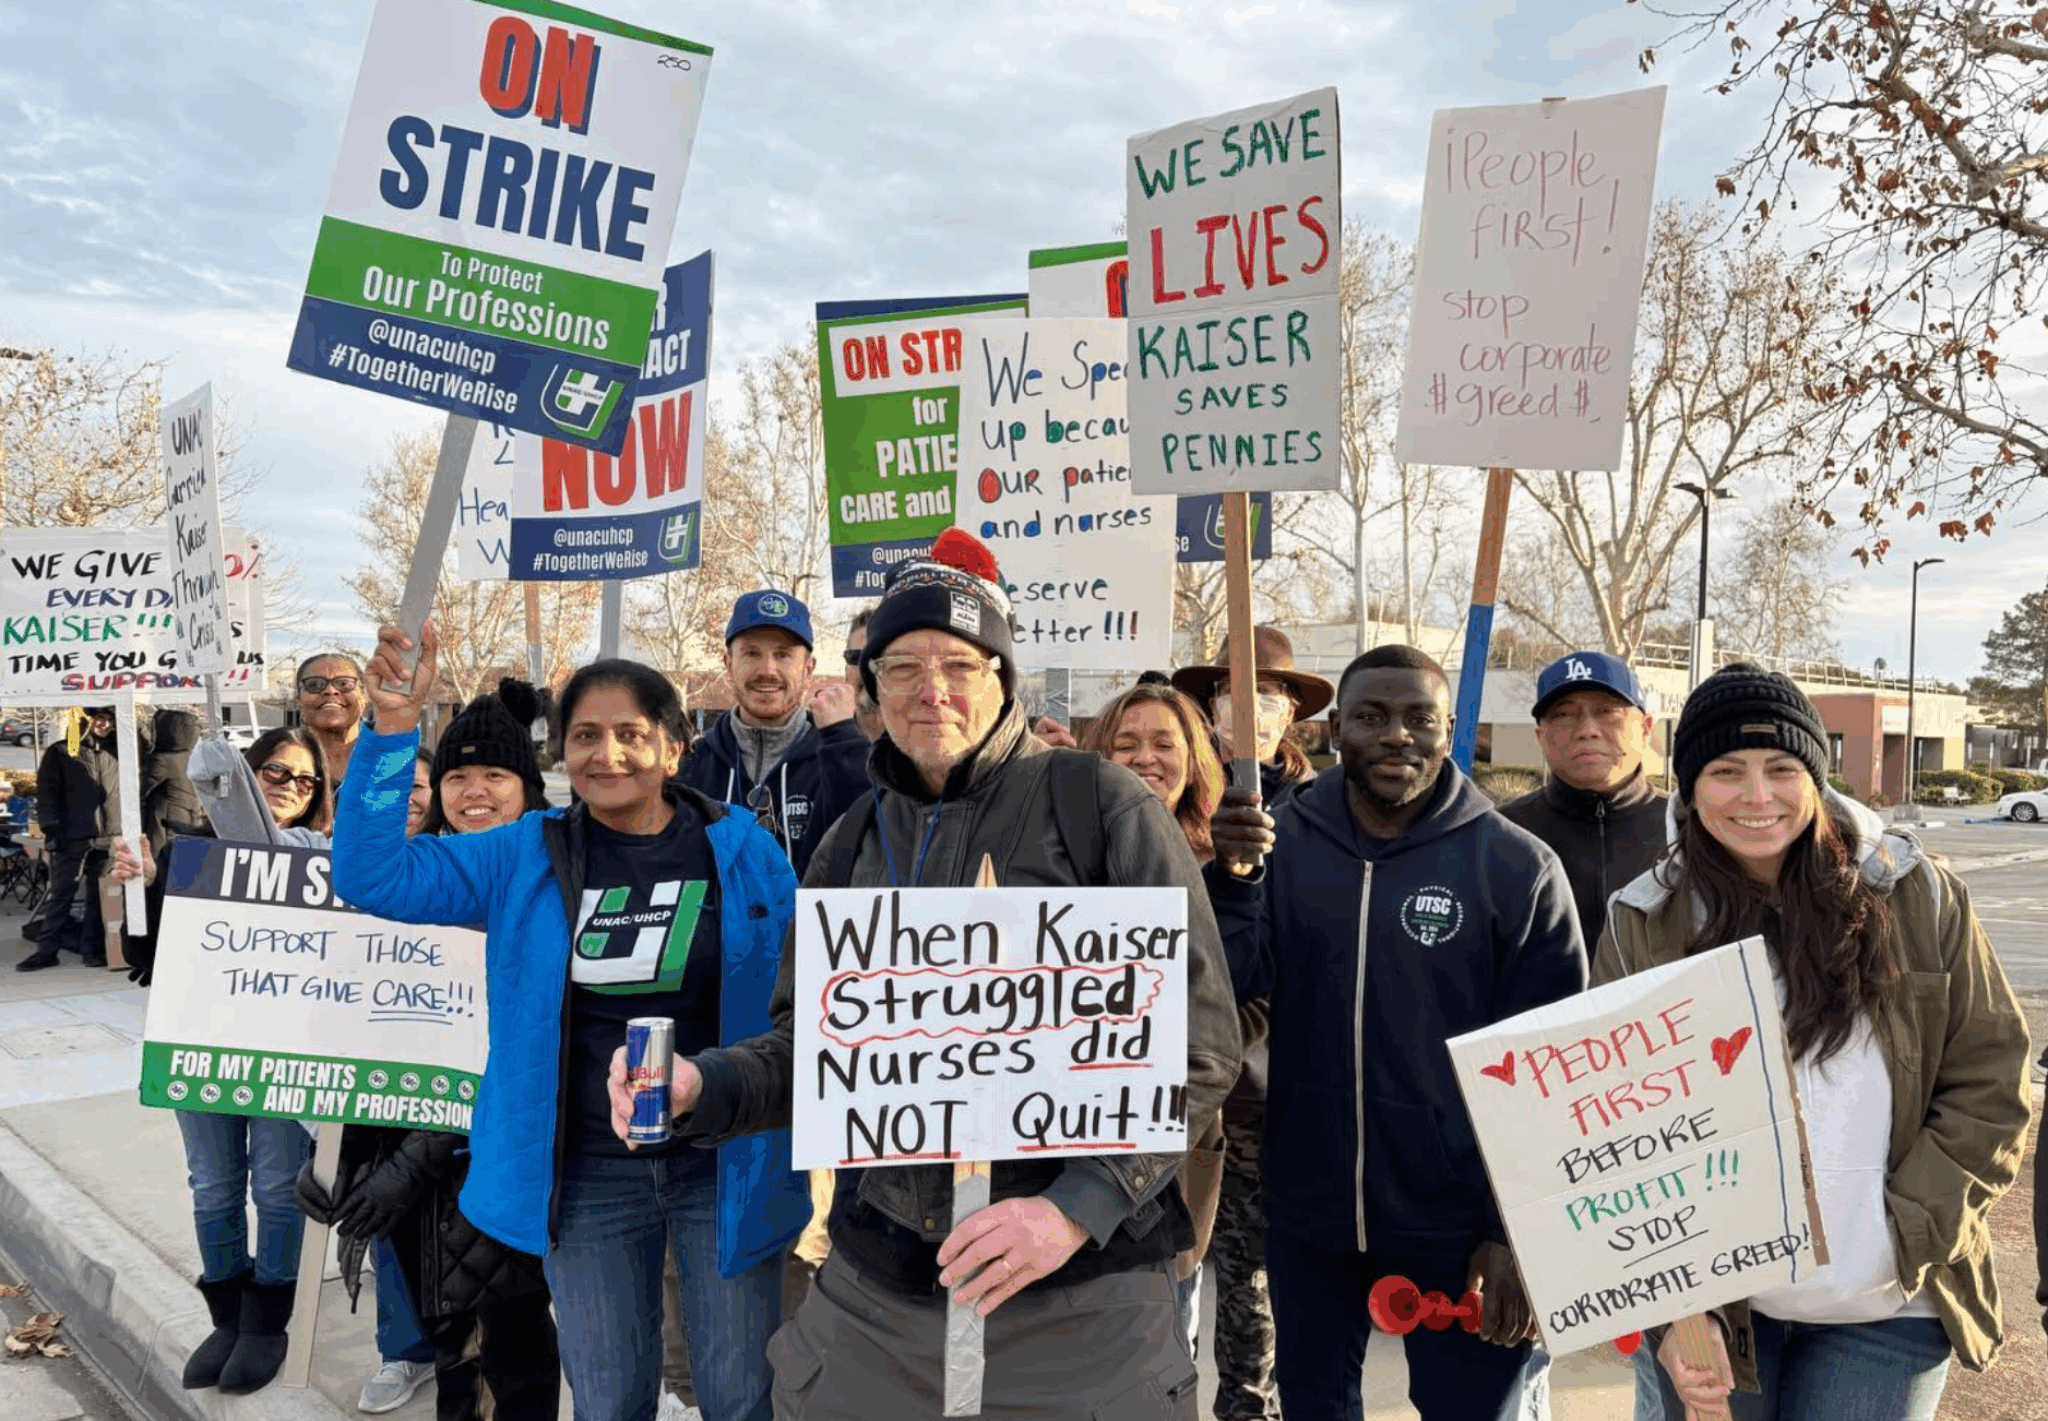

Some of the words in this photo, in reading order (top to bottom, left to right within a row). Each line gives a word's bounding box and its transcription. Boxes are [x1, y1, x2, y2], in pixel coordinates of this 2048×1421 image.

[479, 15, 601, 136] ON
[657, 54, 691, 71] 250
[1134, 139, 1206, 199] WE
[1219, 108, 1327, 178] SAVE
[379, 115, 655, 262] STRIKE
[1149, 194, 1330, 304] LIVES
[441, 251, 464, 278] To
[468, 257, 544, 295] Protect
[362, 265, 420, 310] Our
[425, 278, 610, 351] Professions
[1442, 289, 1529, 340] stop
[368, 319, 496, 375] @unacuhcp
[842, 335, 890, 382] ON
[900, 327, 962, 376] STR
[1137, 309, 1312, 380] KAISER
[1459, 323, 1612, 391] corporate
[329, 343, 519, 414] #TogetherWeRise
[982, 331, 1043, 407] We
[1061, 340, 1129, 400] Spe
[912, 395, 948, 426] for
[1174, 383, 1289, 416] SAVES
[1045, 409, 1129, 444] becau
[542, 390, 693, 513] NOW
[876, 433, 958, 478] PATIE
[1161, 430, 1323, 474] PENNIES
[840, 490, 899, 524] CARE
[905, 485, 952, 518] and
[1063, 459, 1131, 503] patie
[553, 527, 634, 547] @unacuhcp
[980, 510, 1041, 539] and
[1055, 507, 1151, 535] nurses
[11, 552, 65, 580] WE
[74, 549, 163, 584] GIVE
[533, 550, 648, 571] #TogetherWeRise
[46, 587, 137, 609] EVERY
[3, 615, 128, 645] KAISER
[1011, 618, 1093, 644] etter
[8, 652, 80, 674] TIME
[94, 650, 146, 672] YOU
[1564, 658, 1593, 681] LA
[220, 847, 292, 902] I'M
[592, 910, 672, 928] UNAC/UHCP
[1415, 895, 1452, 916] UTSC
[200, 920, 338, 960] SUPPORT
[356, 933, 445, 967] THOSE
[815, 890, 999, 971] When
[1036, 901, 1188, 967] Kaiser
[223, 968, 299, 997] THAT
[301, 976, 363, 1004] GIVE
[827, 963, 1136, 1033] Struggled
[170, 1050, 213, 1078] FOR
[217, 1054, 254, 1081] MY
[259, 1056, 356, 1090] PATIENTS
[817, 1037, 1036, 1101] Nurses
[1070, 1015, 1151, 1065] did
[1521, 998, 1696, 1099] PEOPLE
[263, 1085, 306, 1114] AND
[312, 1090, 350, 1118] MY
[355, 1092, 474, 1130] PROFESSION
[1569, 1059, 1698, 1137] FIRST
[846, 1100, 968, 1160] NOT
[1556, 1107, 1719, 1185] BEFORE
[1565, 1162, 1698, 1232] PROFIT
[1607, 1204, 1697, 1252] STOP
[1548, 1262, 1703, 1335] CORPORATE
[1710, 1221, 1812, 1277] GREED!
